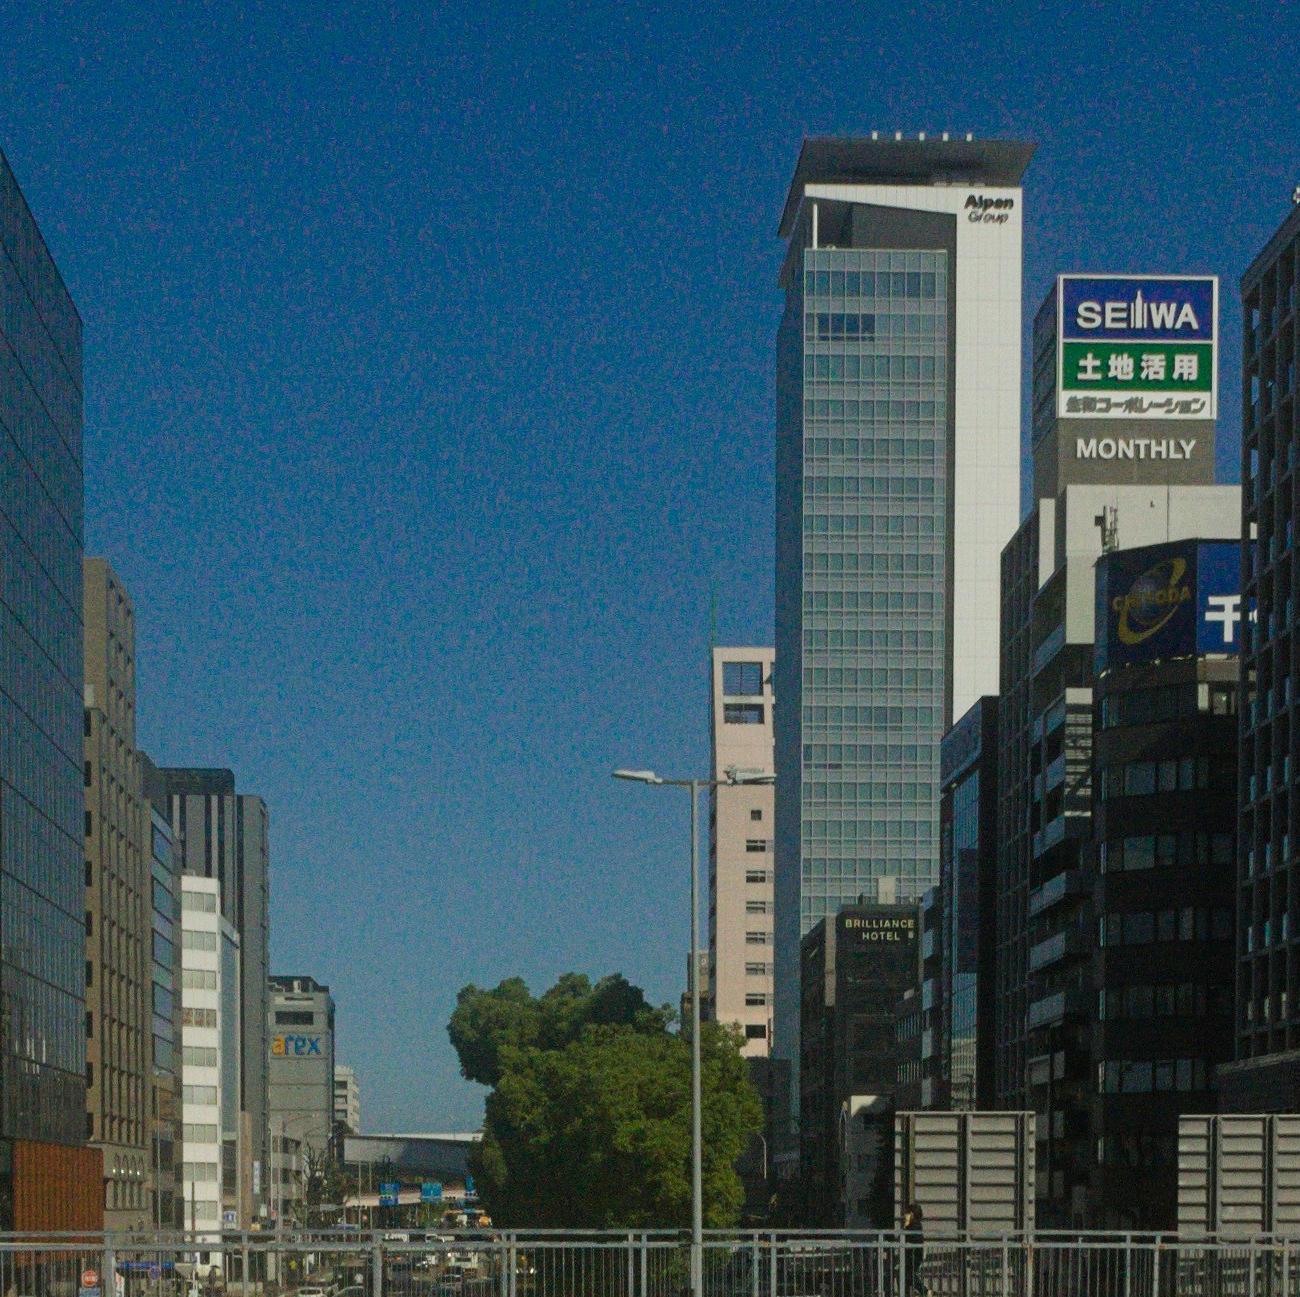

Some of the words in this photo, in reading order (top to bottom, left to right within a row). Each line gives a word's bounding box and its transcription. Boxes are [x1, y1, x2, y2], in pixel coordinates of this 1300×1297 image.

[964, 194, 1014, 212] Alpen
[968, 211, 1008, 225] Group
[1076, 289, 1199, 330] SEIWA
[1077, 353, 1199, 381] 土地活用
[1076, 438, 1197, 459] MONTHLY
[845, 919, 915, 929] BRILLIANCE
[862, 931, 900, 941] HOTEL
[272, 1034, 322, 1056] arex
